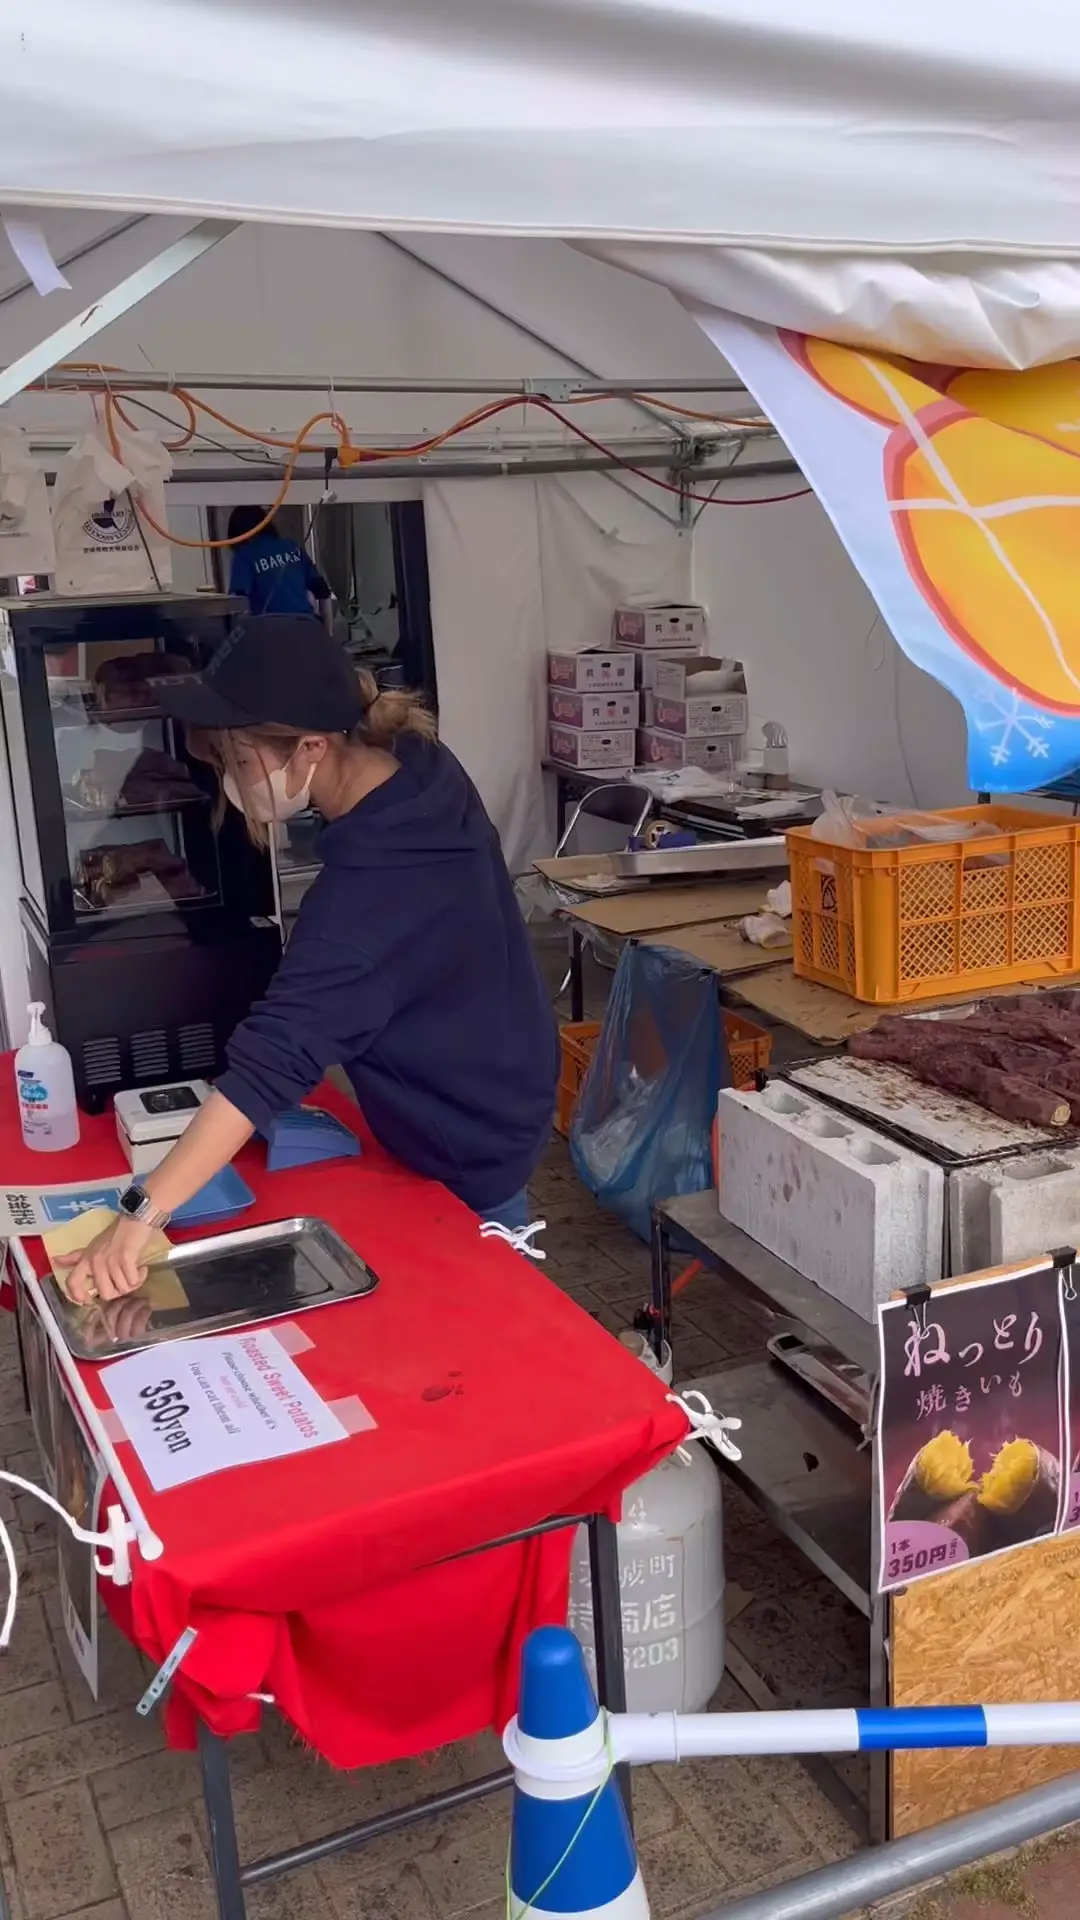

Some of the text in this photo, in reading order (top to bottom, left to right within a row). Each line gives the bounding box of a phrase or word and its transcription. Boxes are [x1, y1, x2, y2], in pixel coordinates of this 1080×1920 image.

[903, 1311, 1043, 1378] ねっとり
[234, 1367, 251, 1391] choose
[249, 1388, 270, 1419] whether
[238, 1336, 319, 1439] Roasted Sweet Potatos
[915, 1370, 1024, 1421] 焼きいも
[139, 1378, 193, 1454] 350yen
[212, 1401, 230, 1428] them
[888, 1544, 947, 1577] 350円
